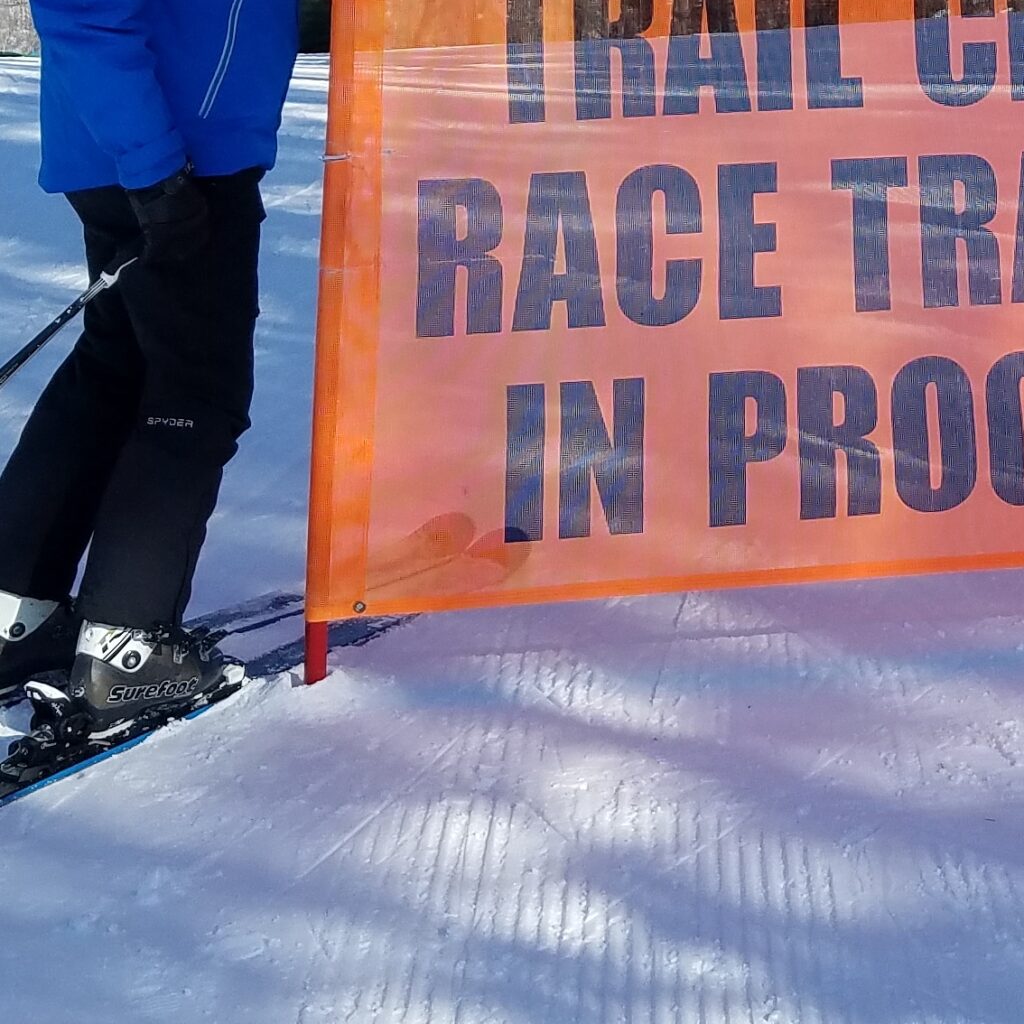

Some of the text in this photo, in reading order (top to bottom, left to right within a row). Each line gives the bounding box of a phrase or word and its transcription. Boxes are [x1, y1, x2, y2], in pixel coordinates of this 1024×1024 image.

[416, 163, 783, 338] RACE
[146, 417, 194, 428] SPYDER
[504, 377, 645, 544] IN
[107, 677, 199, 703] Surefoot
